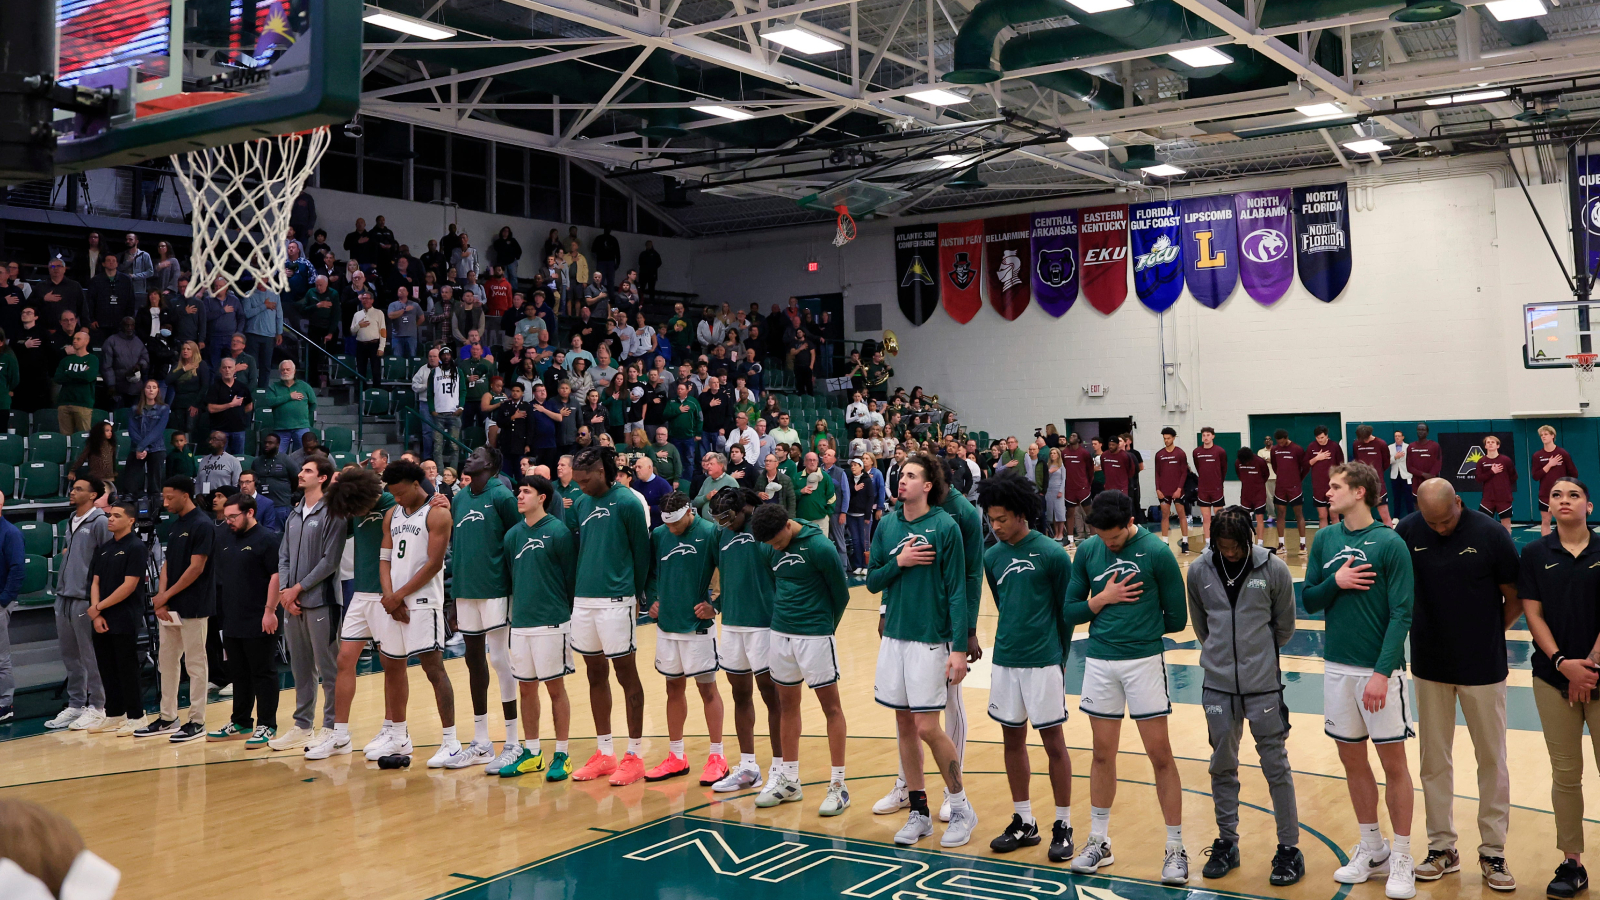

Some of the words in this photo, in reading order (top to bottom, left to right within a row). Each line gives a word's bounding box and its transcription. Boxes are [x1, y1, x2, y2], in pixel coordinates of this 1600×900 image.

[1246, 196, 1280, 208] NORTH
[1305, 190, 1339, 203] NORTH
[1136, 207, 1174, 219] FLORIDA
[1240, 206, 1288, 220] ALABAMA
[1302, 200, 1343, 215] FLORIDA
[1035, 215, 1073, 227] CENTRAL
[1084, 210, 1124, 223] EASTERN
[1184, 209, 1233, 223] LIPSCOMB
[1081, 220, 1127, 233] KENTUCKY
[1130, 219, 1152, 231] GULF
[1152, 216, 1181, 229] COAST
[1309, 223, 1336, 236] NORTH
[896, 232, 923, 241] ATLANTIC
[924, 231, 937, 239] SUN
[985, 230, 1030, 243] BELLARMINE
[1032, 224, 1078, 238] ARKANSAS
[898, 239, 935, 249] CONFERENCE
[940, 236, 964, 247] AUSTIN
[965, 234, 983, 244] PEAY
[1302, 231, 1344, 250] FLORIDA
[1085, 246, 1127, 262] EKU
[1194, 230, 1226, 269] L
[1134, 244, 1181, 272] FGCU
[1090, 384, 1101, 394] EXIT
[390, 523, 422, 538] DOLPHINS
[396, 539, 407, 559] 9
